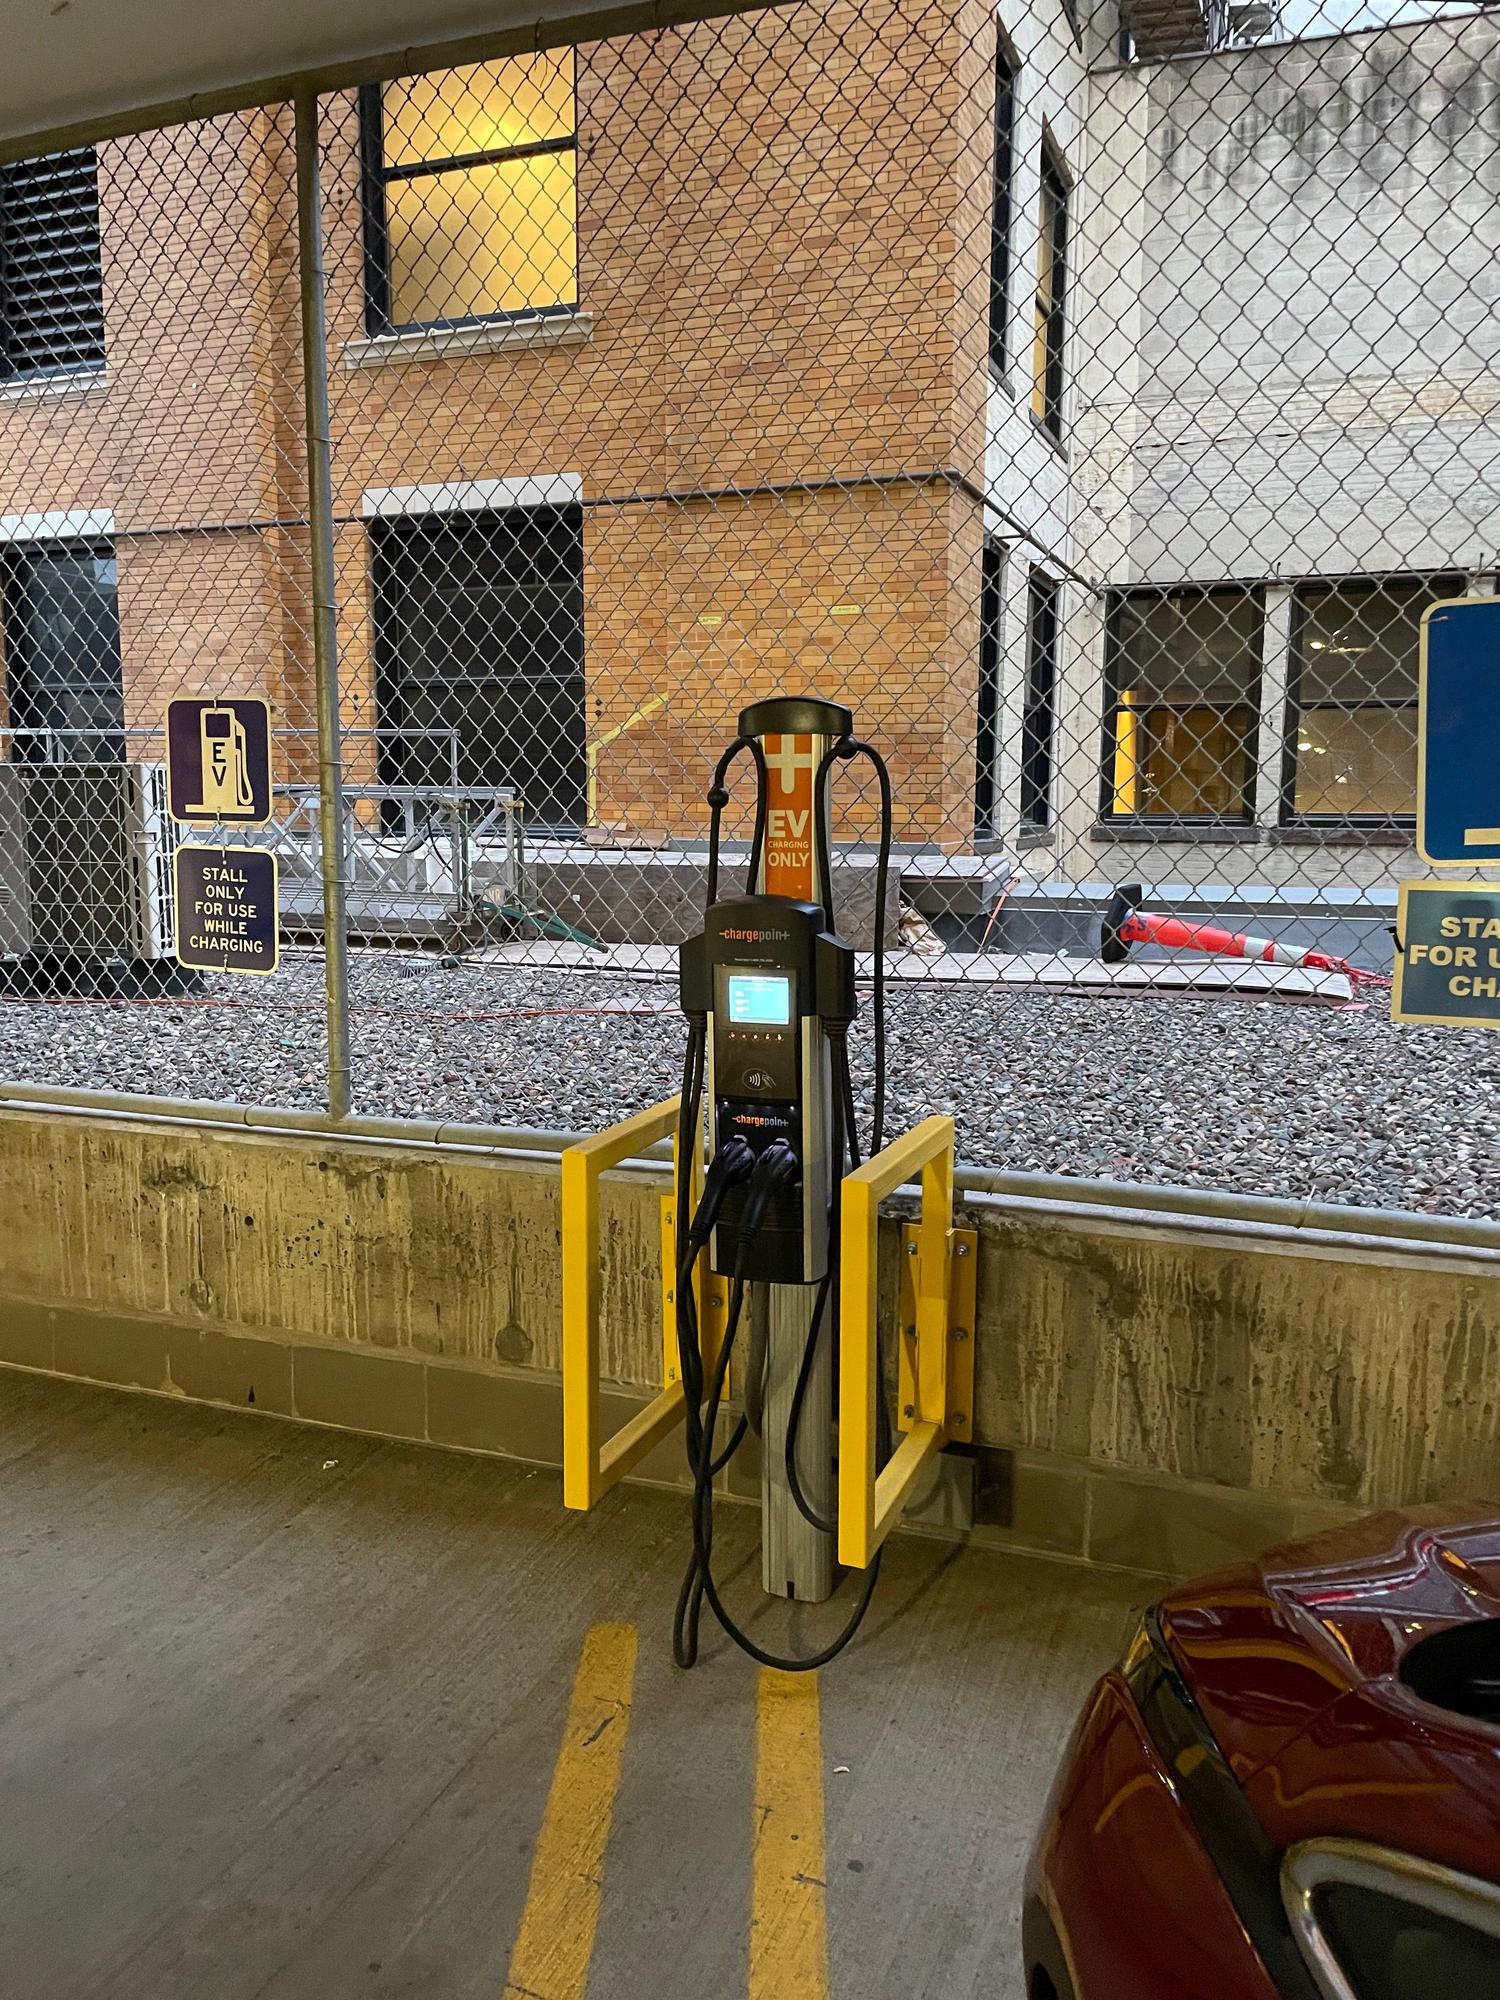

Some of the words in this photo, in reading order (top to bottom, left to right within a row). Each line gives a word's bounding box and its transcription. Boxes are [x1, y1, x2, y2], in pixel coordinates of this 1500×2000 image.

[768, 809, 809, 838] EV
[768, 841, 809, 849] CHARGING
[768, 852, 810, 867] ONLY
[202, 867, 248, 883] STALL
[205, 884, 245, 900] ONLY
[195, 901, 223, 916] FOR
[228, 903, 257, 919] USE
[204, 919, 248, 935] WHILE
[1439, 916, 1500, 939] STA
[189, 935, 263, 954] CHARGING
[1409, 944, 1478, 968] FOR
[1448, 975, 1500, 998] CH
